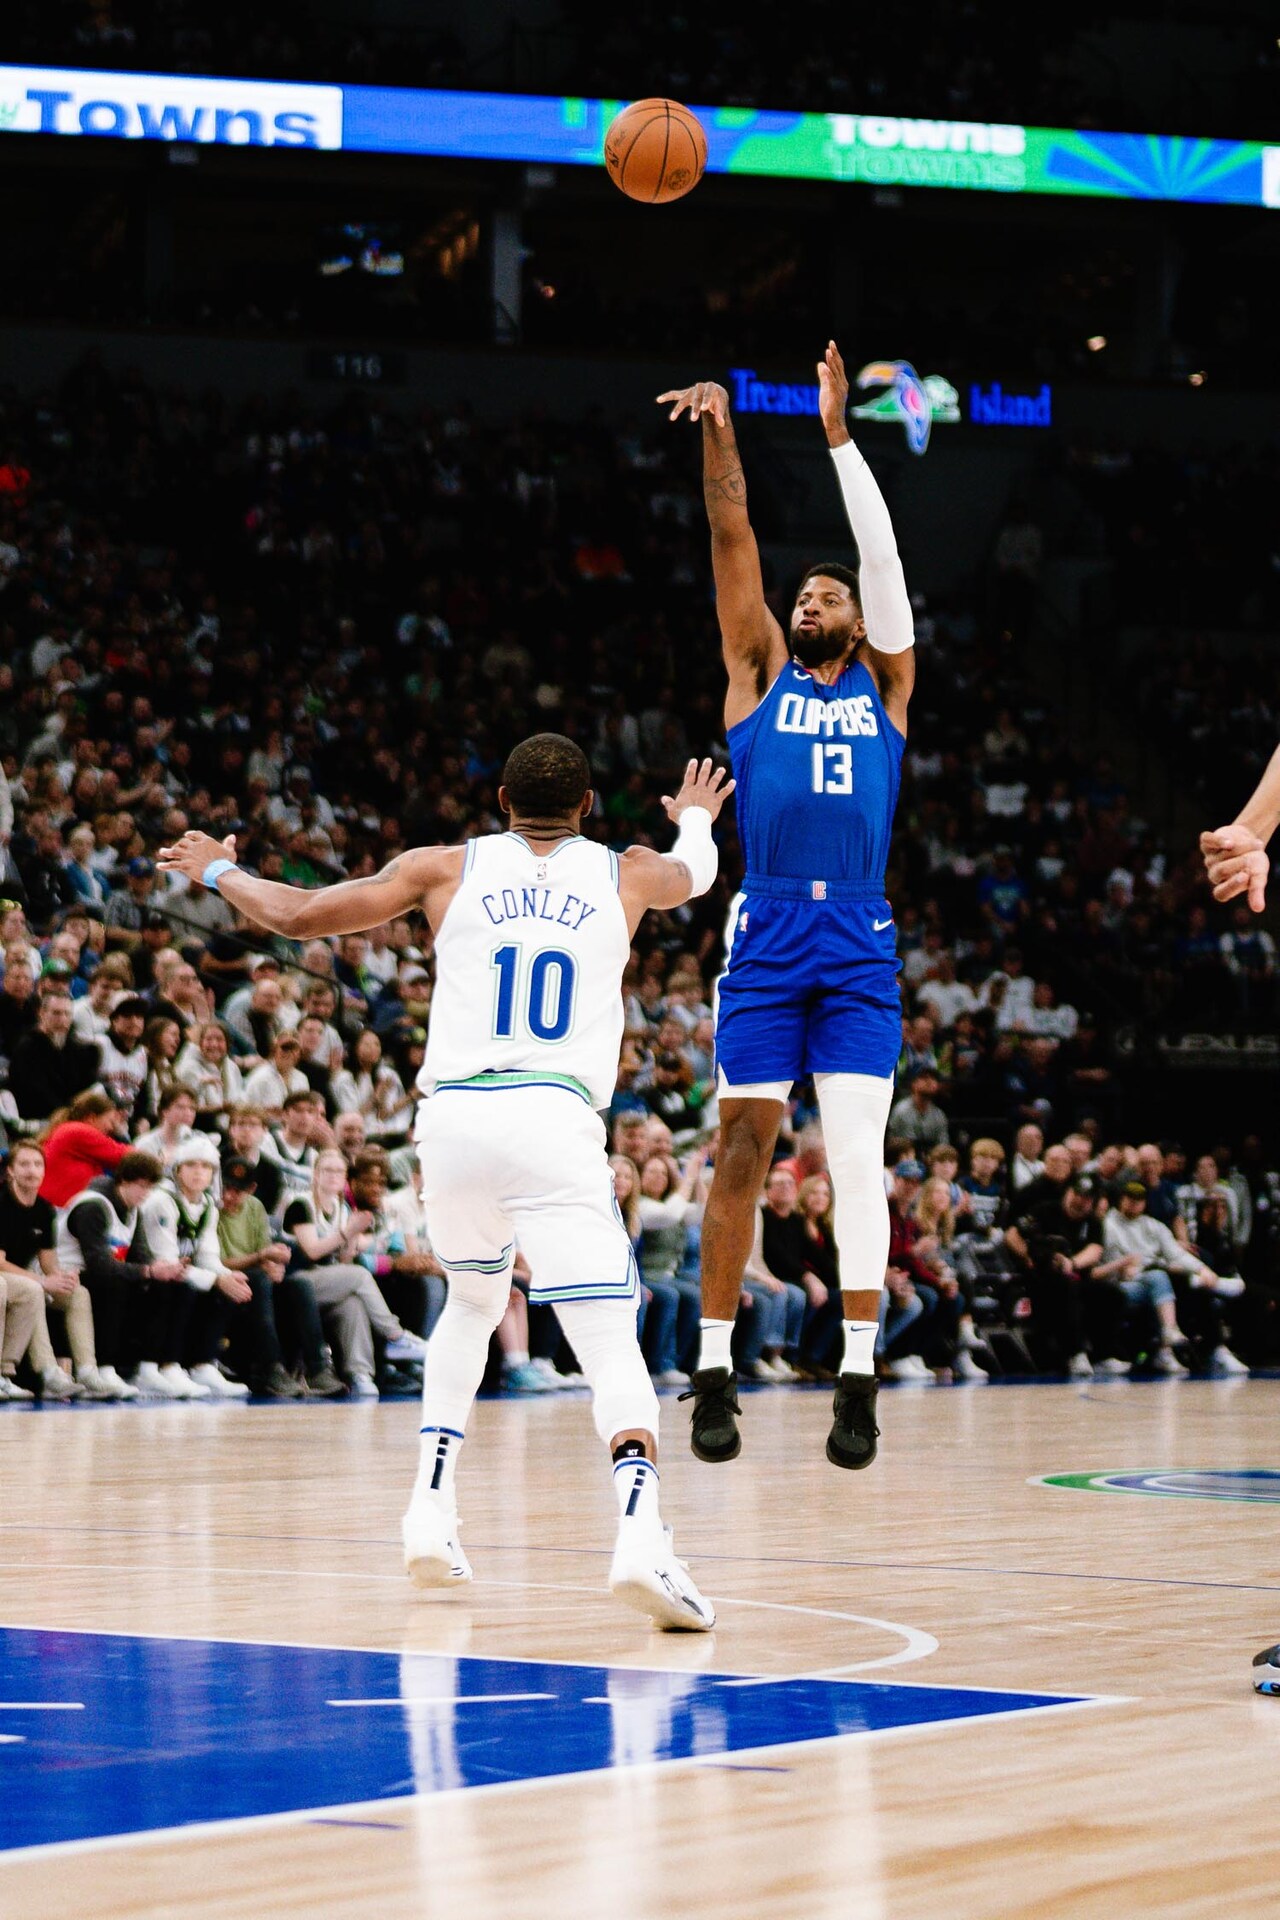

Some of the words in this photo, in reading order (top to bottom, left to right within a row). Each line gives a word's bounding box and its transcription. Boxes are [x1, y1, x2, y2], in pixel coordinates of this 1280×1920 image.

[26, 89, 319, 149] Towns
[335, 353, 382, 379] 116
[729, 368, 820, 415] Treasu
[970, 381, 1051, 427] Island
[777, 692, 878, 737] CLIPPERS
[812, 742, 853, 794] 13
[482, 888, 597, 931] CONLEY
[489, 941, 580, 1046] 10
